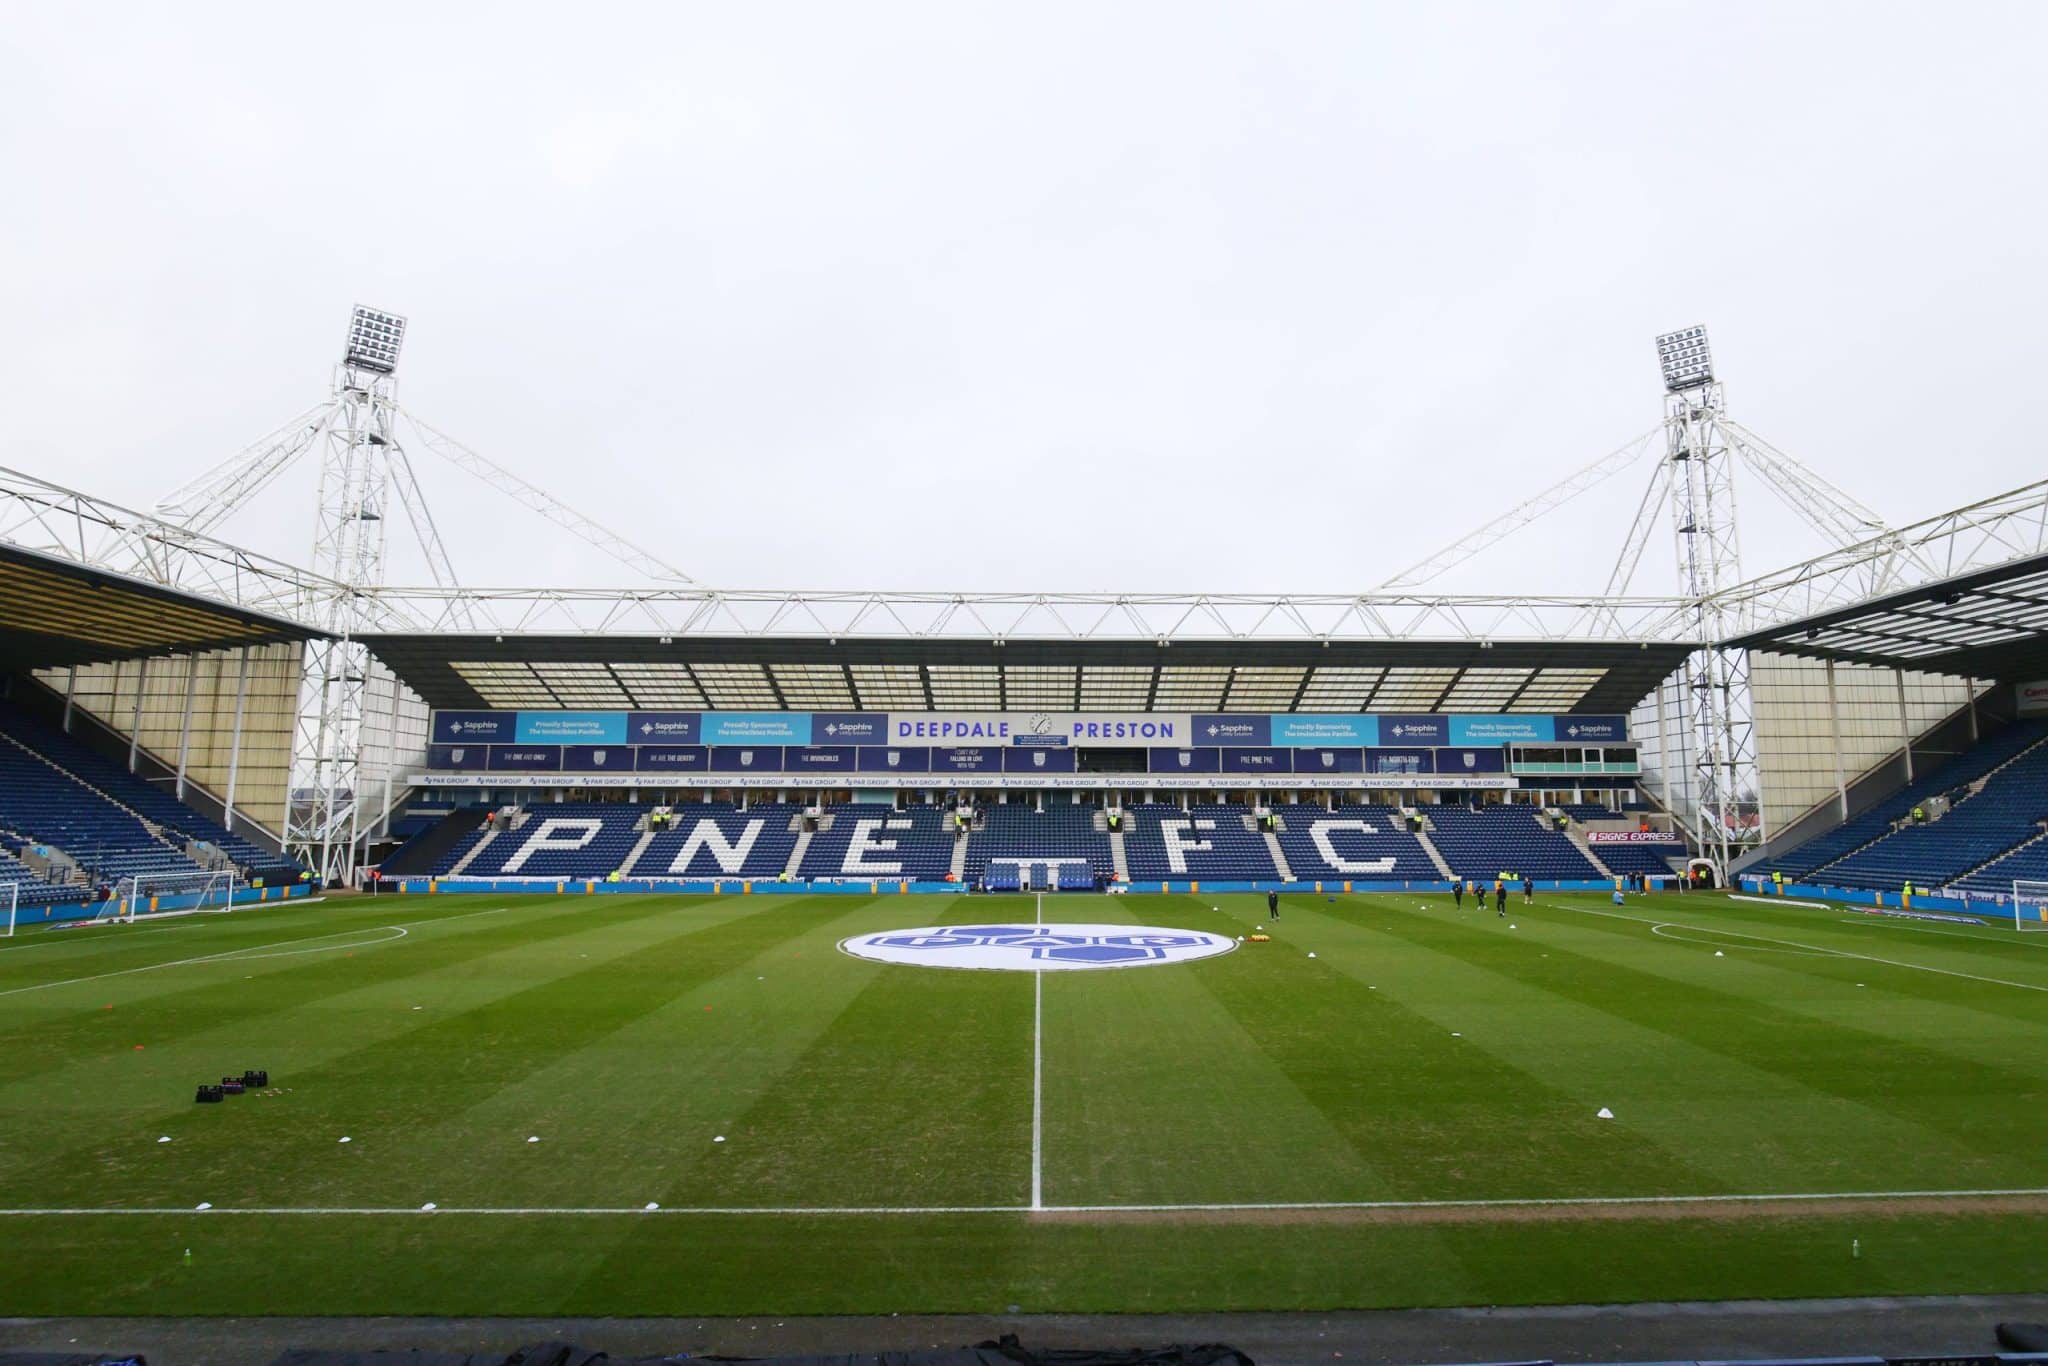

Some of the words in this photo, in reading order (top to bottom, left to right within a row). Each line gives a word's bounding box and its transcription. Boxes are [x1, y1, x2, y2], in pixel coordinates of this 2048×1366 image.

[464, 721, 498, 731] Sapphire
[656, 721, 688, 731] Sapphire
[839, 723, 872, 732] Sapphire
[899, 722, 1008, 737] DEEPDALE
[1074, 722, 1173, 738] PRESTON
[1221, 725, 1253, 733] Sapphire
[1405, 725, 1437, 733] Sapphire
[1580, 725, 1613, 733] Sapphire
[1598, 832, 1628, 840] SIGNS
[1630, 832, 1675, 840] EXPRESS
